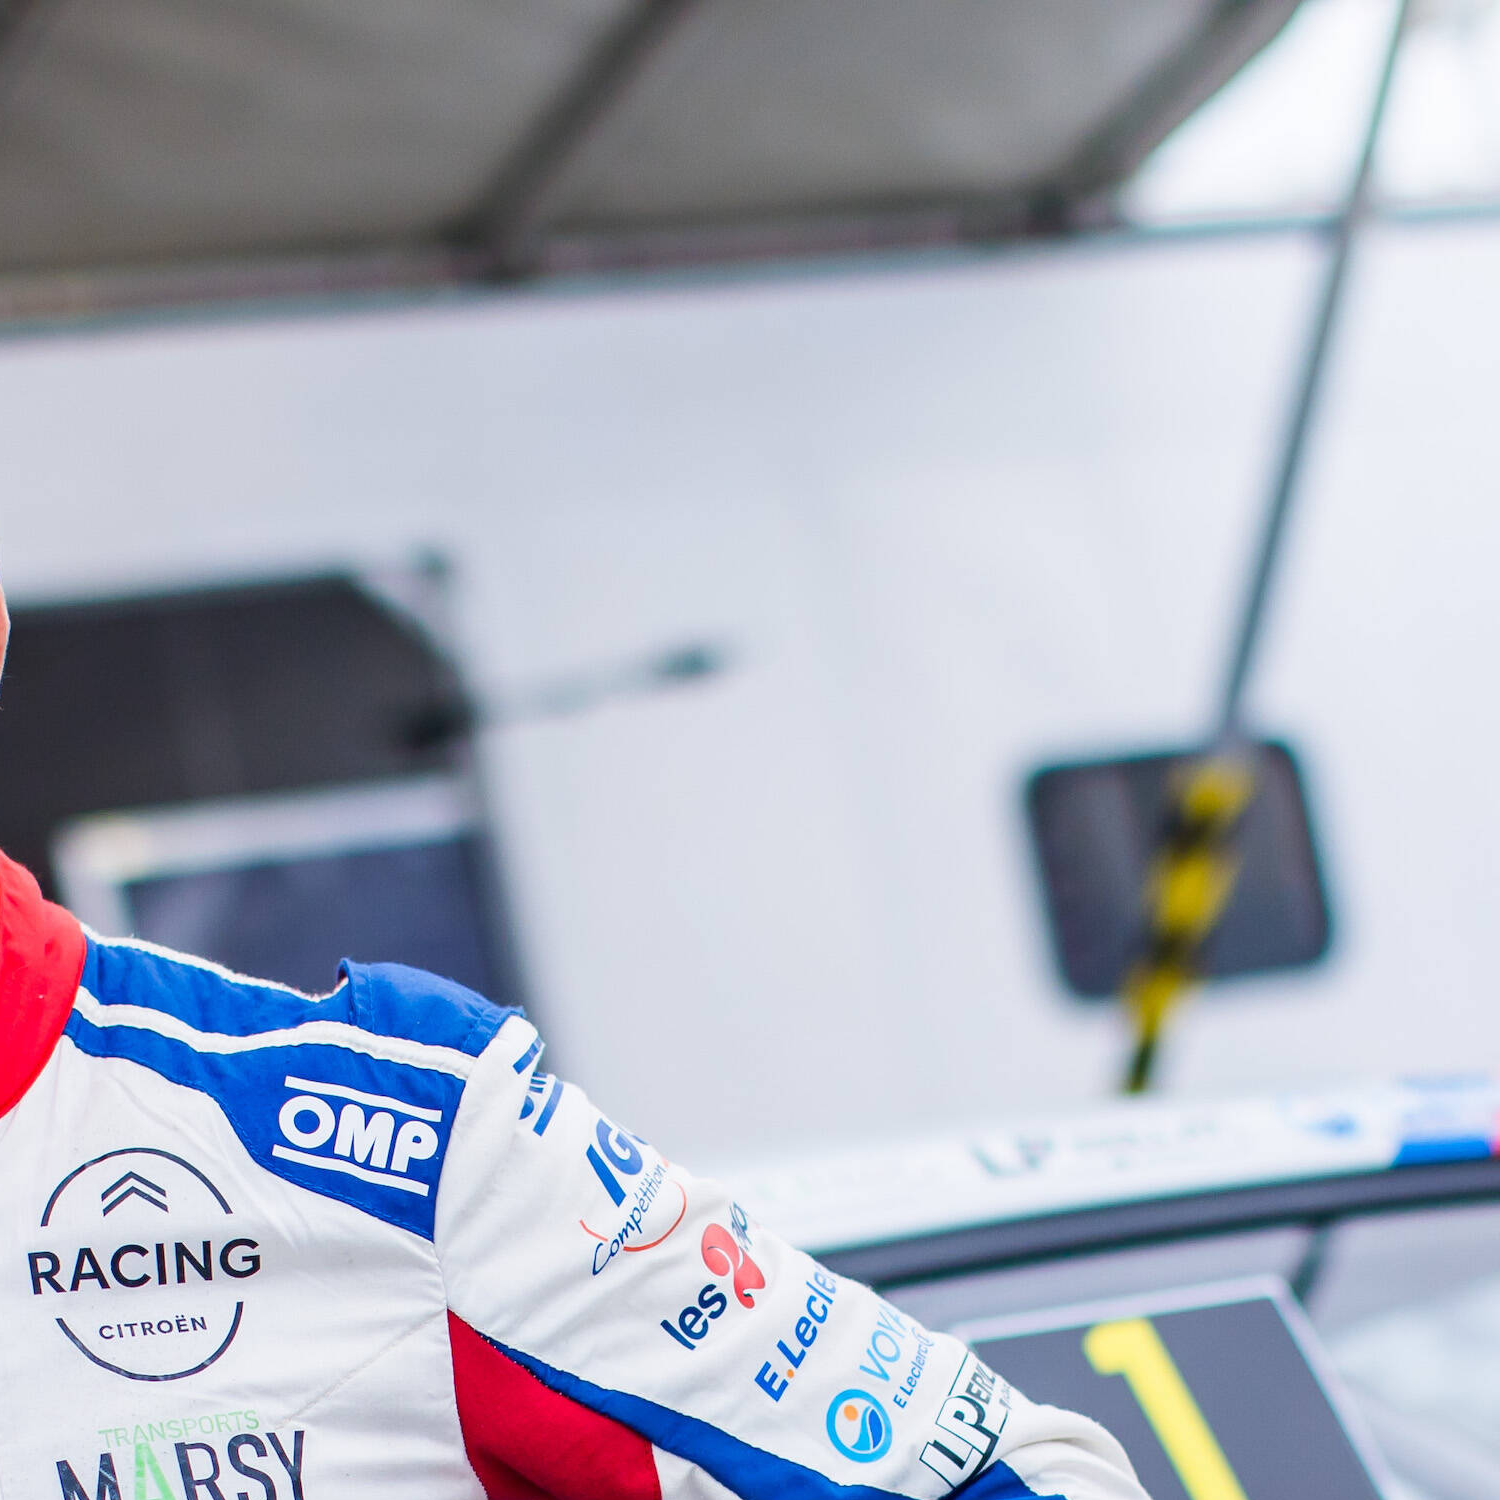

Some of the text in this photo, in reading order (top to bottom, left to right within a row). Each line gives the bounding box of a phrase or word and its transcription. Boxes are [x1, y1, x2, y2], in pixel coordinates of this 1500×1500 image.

[278, 1094, 439, 1173] OMP
[27, 1238, 262, 1296] RACING
[660, 1283, 728, 1351] les
[701, 1223, 766, 1310] 2
[98, 1313, 209, 1340] CITROËN
[98, 1410, 260, 1450] TRANSPORTS
